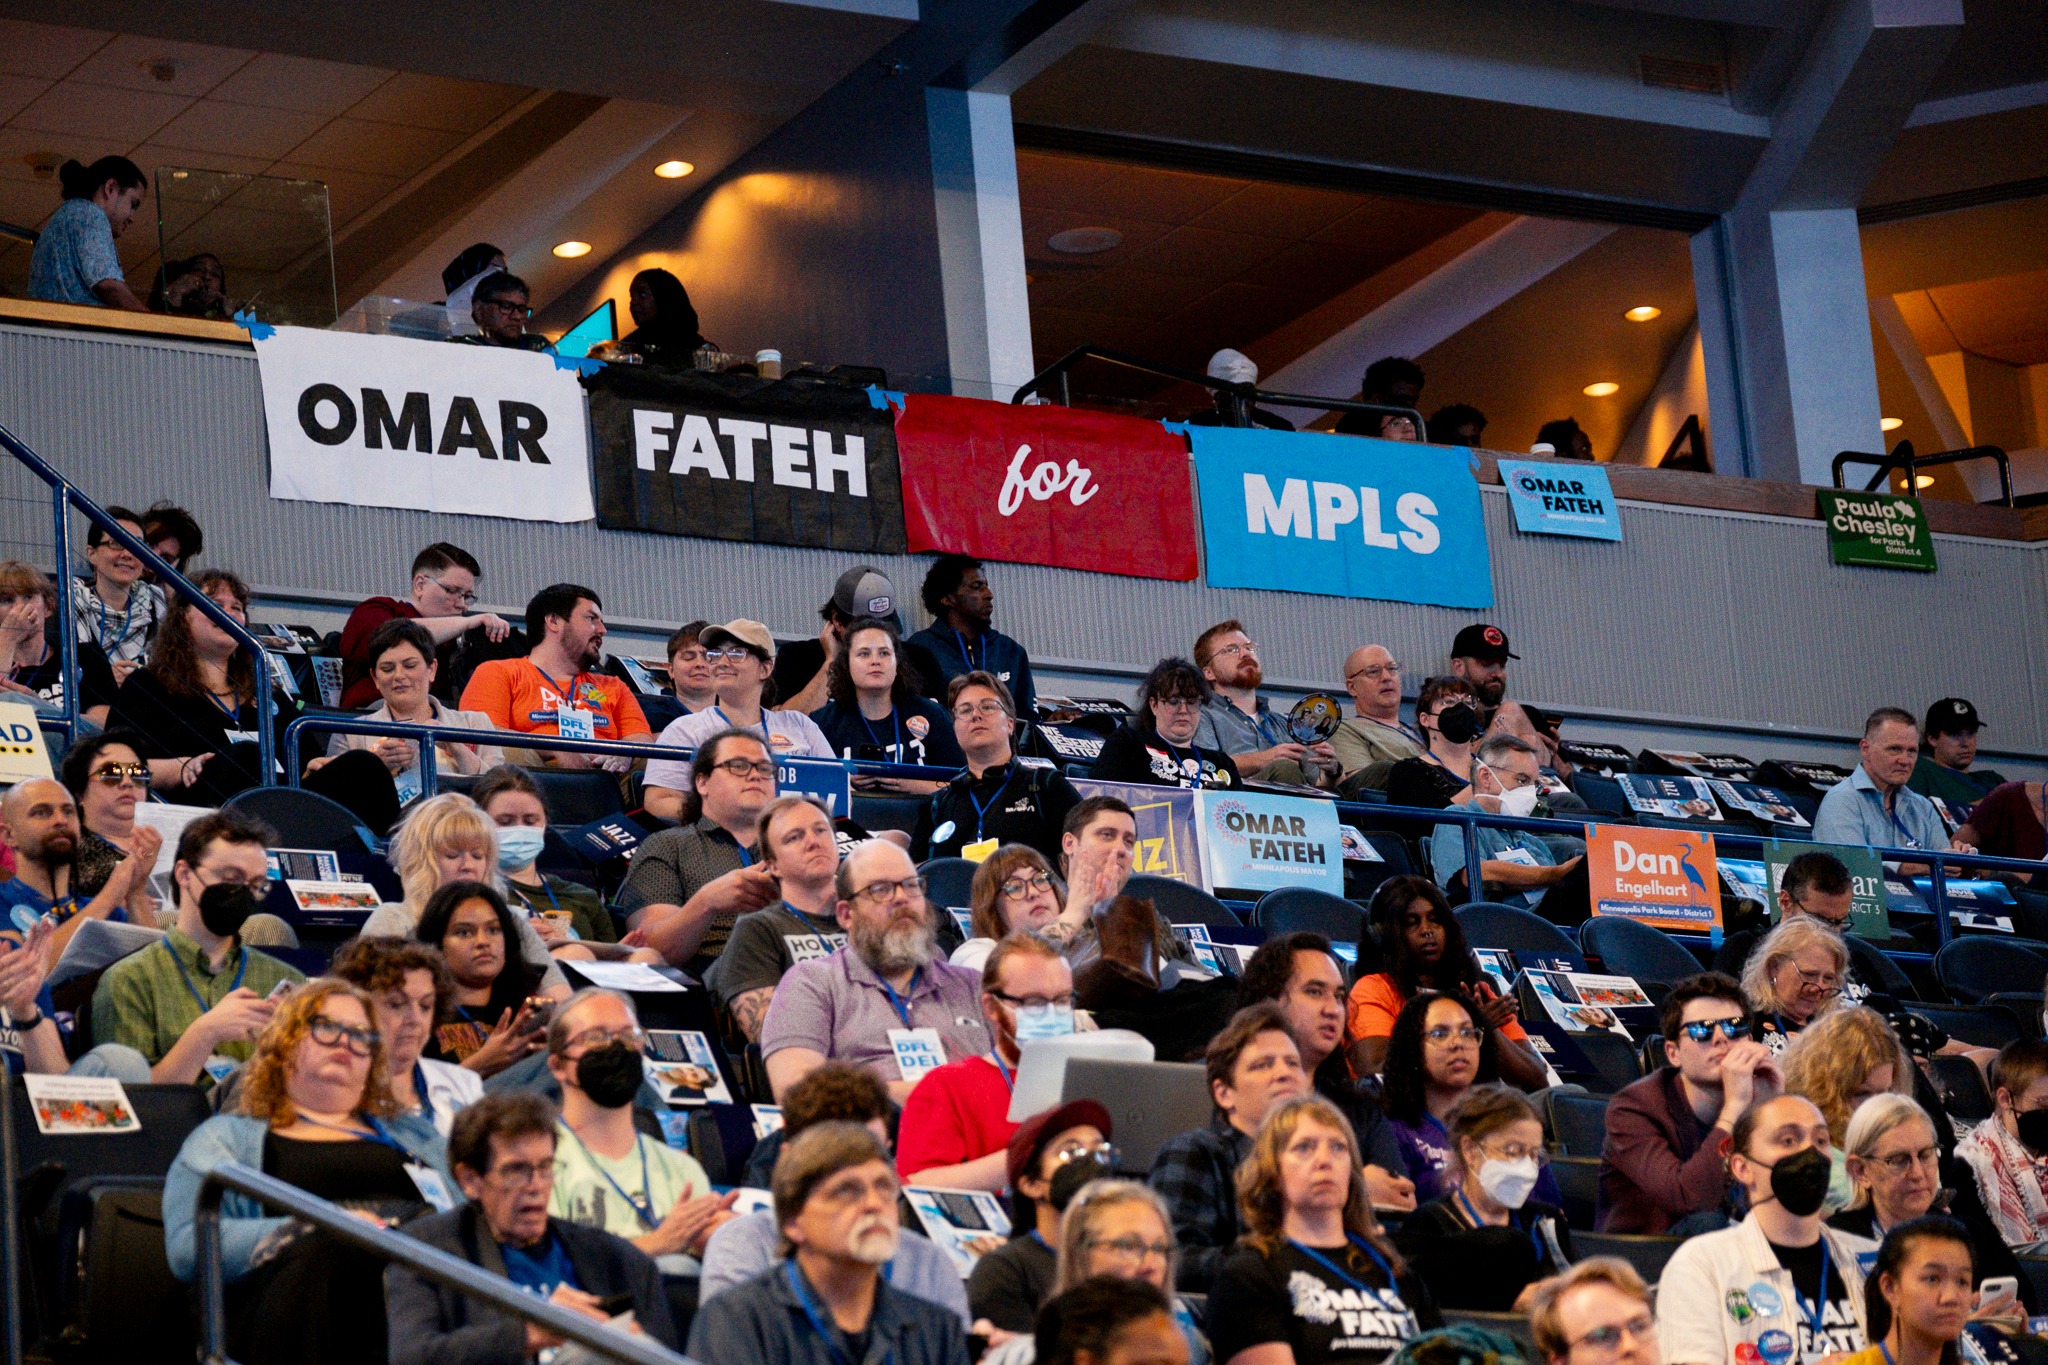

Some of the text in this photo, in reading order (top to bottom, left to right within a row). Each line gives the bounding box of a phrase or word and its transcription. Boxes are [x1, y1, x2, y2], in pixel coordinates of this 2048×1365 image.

[297, 382, 552, 466] OMAR
[631, 408, 868, 498] FATEH
[997, 443, 1099, 516] for
[1520, 477, 1585, 495] OMAR
[1243, 472, 1440, 555] MPLS
[1542, 495, 1605, 515] FATEH
[1834, 497, 1897, 519] Paula
[1833, 514, 1916, 543] Chesley
[1870, 536, 1906, 547] for Parks
[1885, 545, 1915, 555] District
[560, 717, 587, 731] DFL
[1043, 736, 1104, 750] DESERVE
[777, 766, 797, 784] OB
[600, 823, 637, 846] JAZZ
[1225, 811, 1307, 838] OMAR
[1249, 838, 1327, 865] FATEH
[1613, 840, 1679, 875] Dan
[1252, 863, 1300, 874] MINNEAPOLIS
[1300, 867, 1327, 876] MAYOR
[1615, 878, 1688, 898] Engelhart
[1851, 875, 1879, 897] ar
[1600, 903, 1641, 914] Minneapolis
[1659, 908, 1680, 916] Board
[1684, 909, 1708, 917] District
[1851, 901, 1880, 915] RICT 3
[1554, 958, 1574, 972] JA
[896, 1042, 933, 1053] DFL
